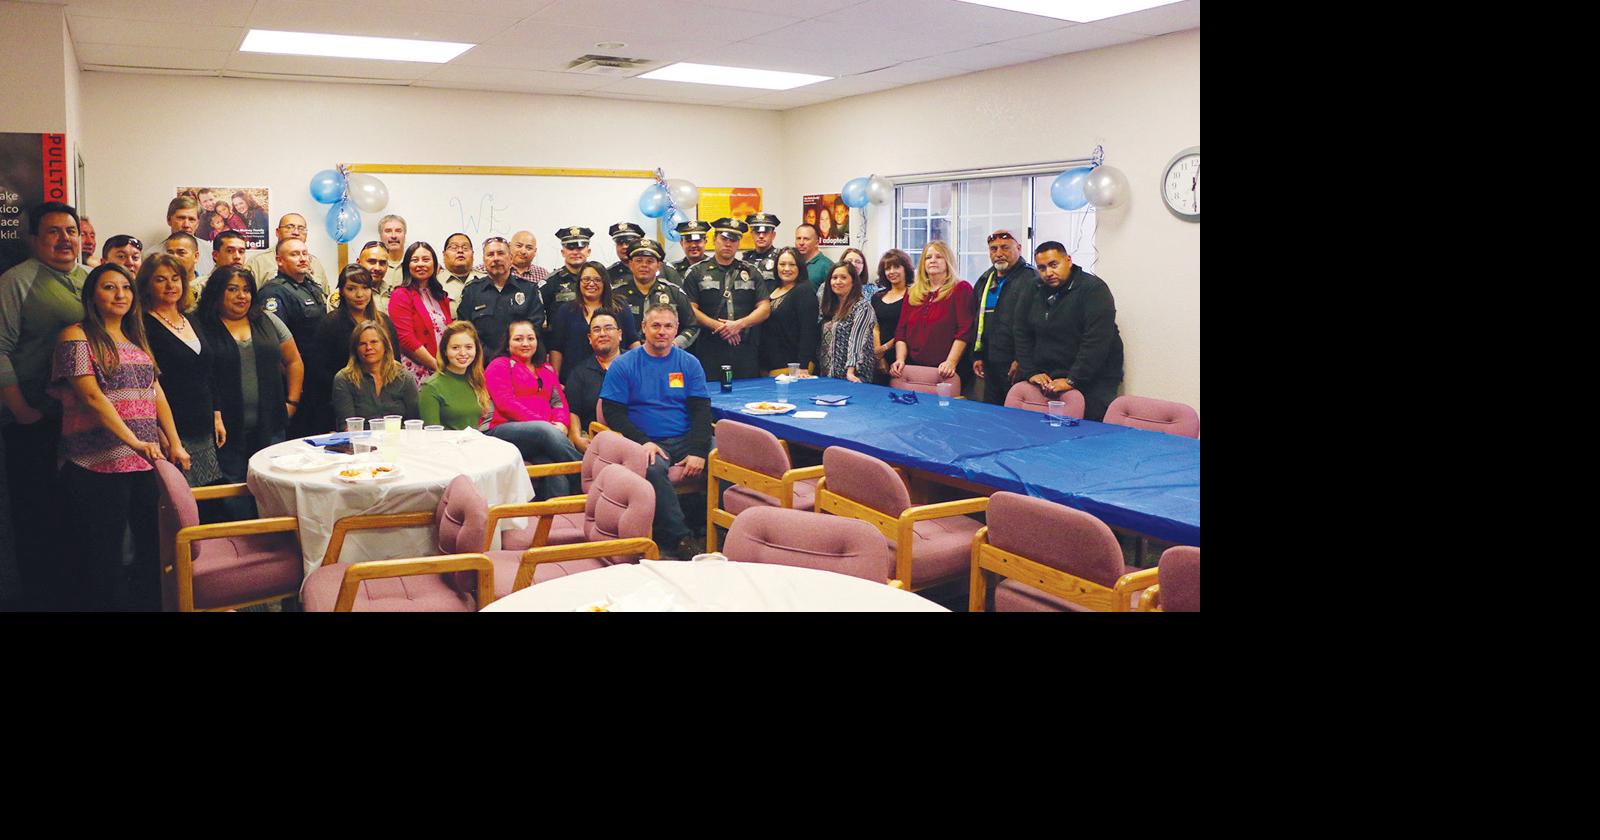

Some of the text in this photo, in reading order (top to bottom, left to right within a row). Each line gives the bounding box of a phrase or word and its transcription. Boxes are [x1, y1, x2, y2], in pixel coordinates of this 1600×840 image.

[48, 134, 64, 199] PULLTO
[1181, 162, 1188, 170] 11
[0, 230, 20, 240] kid.
[245, 239, 265, 248] ted!
